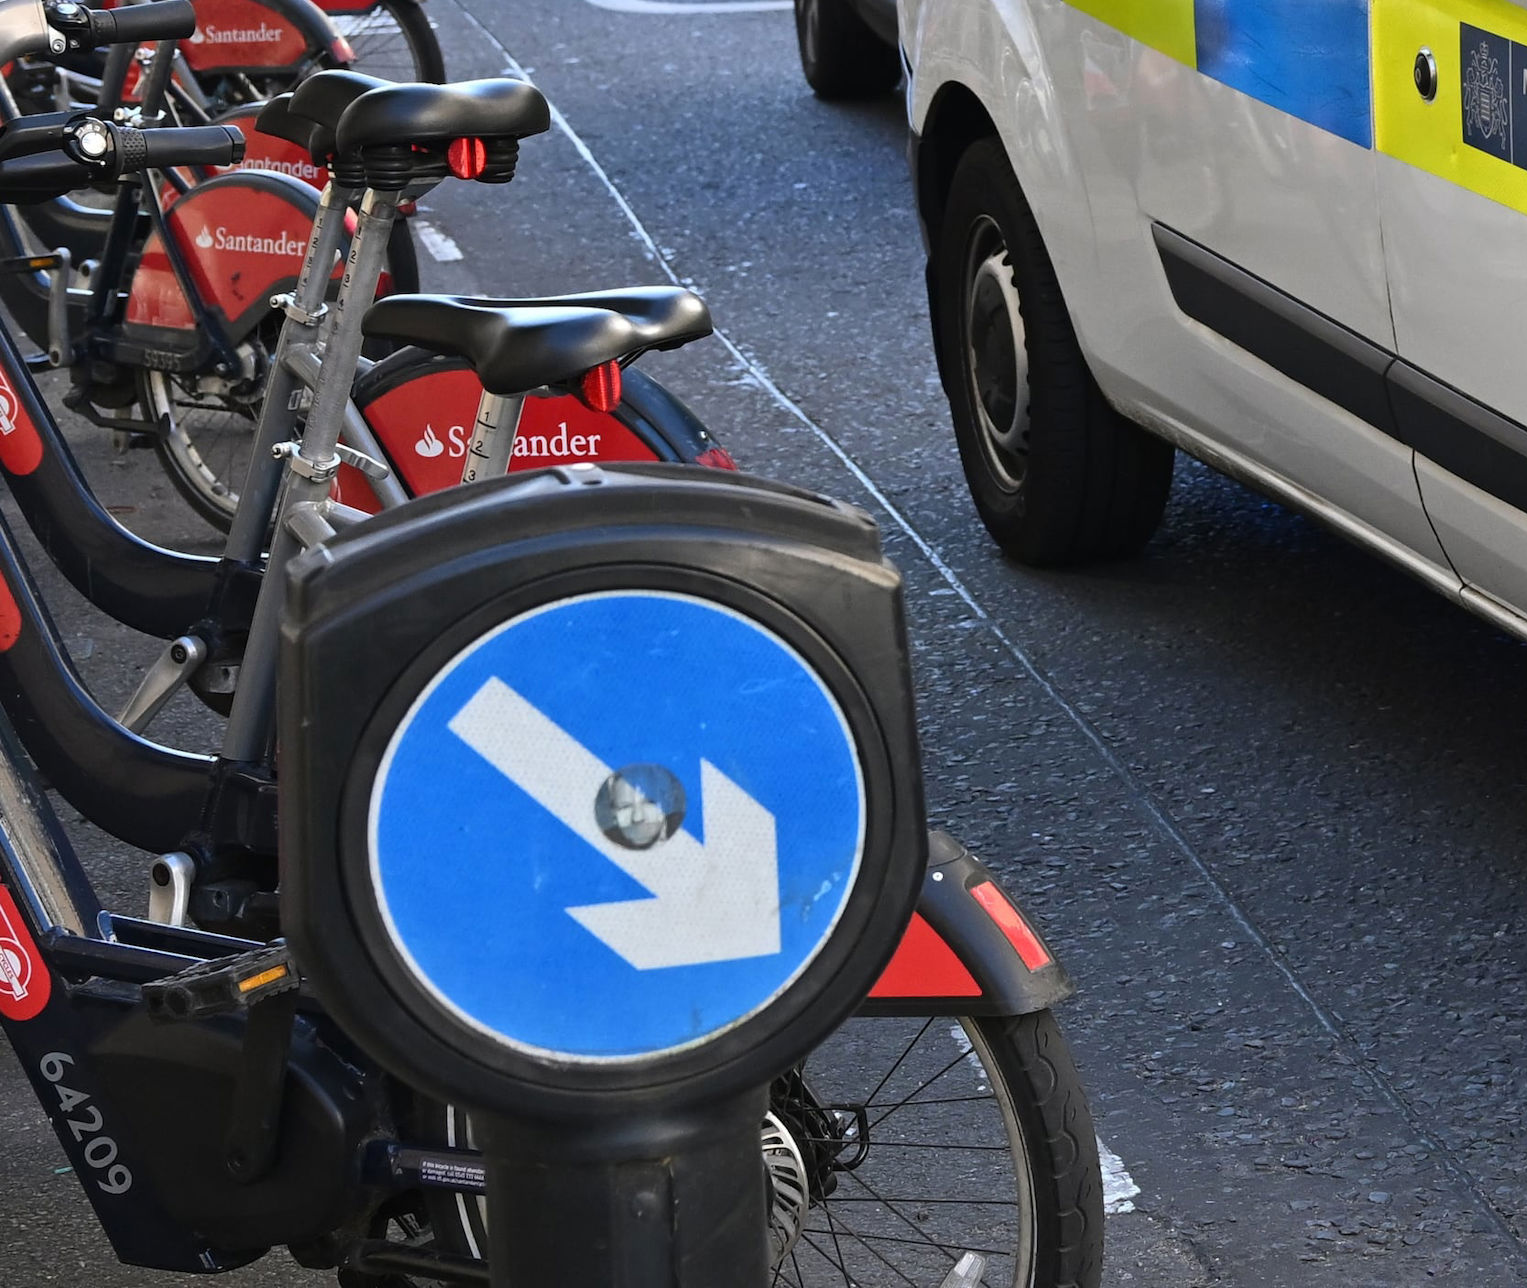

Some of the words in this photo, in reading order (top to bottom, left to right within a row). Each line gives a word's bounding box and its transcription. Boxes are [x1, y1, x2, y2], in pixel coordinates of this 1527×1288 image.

[205, 23, 283, 45] Santander
[239, 156, 321, 180] antander
[214, 226, 307, 257] Santander
[448, 421, 602, 459] Sander
[39, 1051, 133, 1195] 64209
